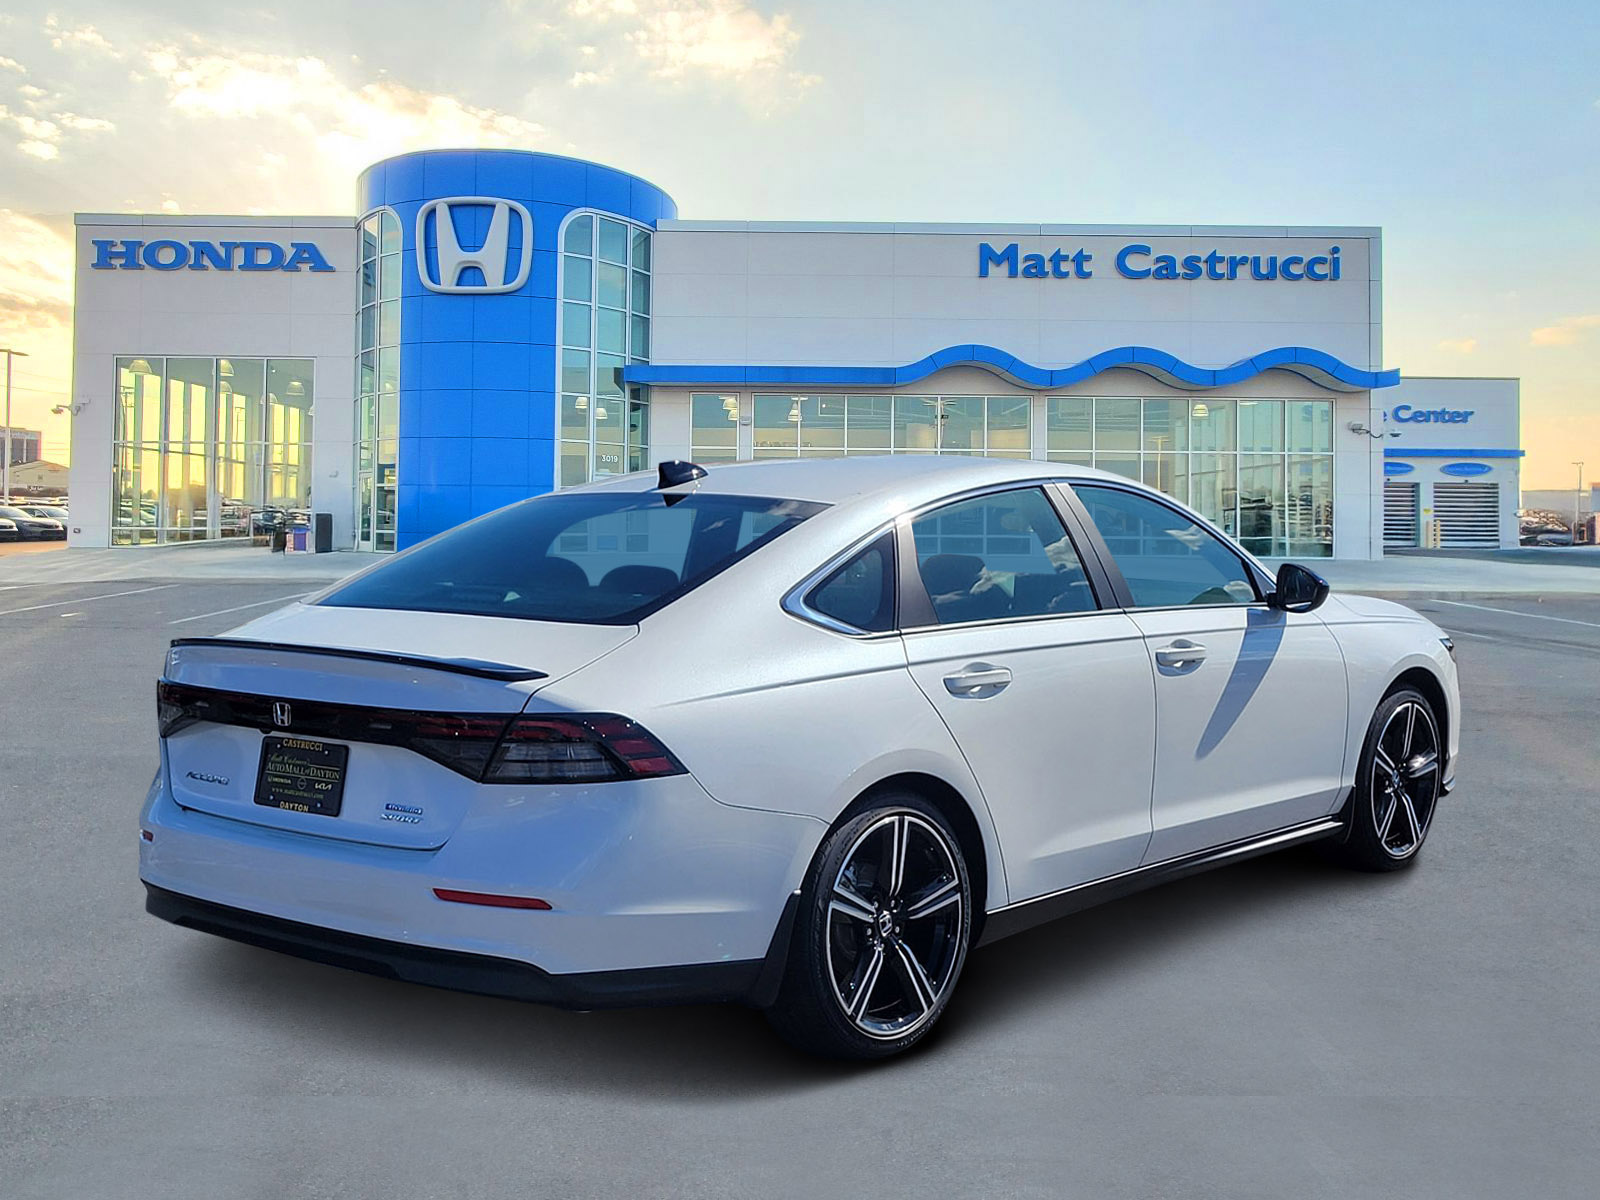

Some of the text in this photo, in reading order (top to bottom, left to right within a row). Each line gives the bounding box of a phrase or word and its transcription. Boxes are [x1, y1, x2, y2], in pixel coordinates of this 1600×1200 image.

[91, 239, 336, 272] HONDA
[979, 243, 1342, 281] Matt Castrucci
[1391, 404, 1475, 424] Center
[601, 454, 619, 463] 3019
[282, 738, 324, 752] CASTRUCCI
[279, 800, 309, 812] DAYTON
